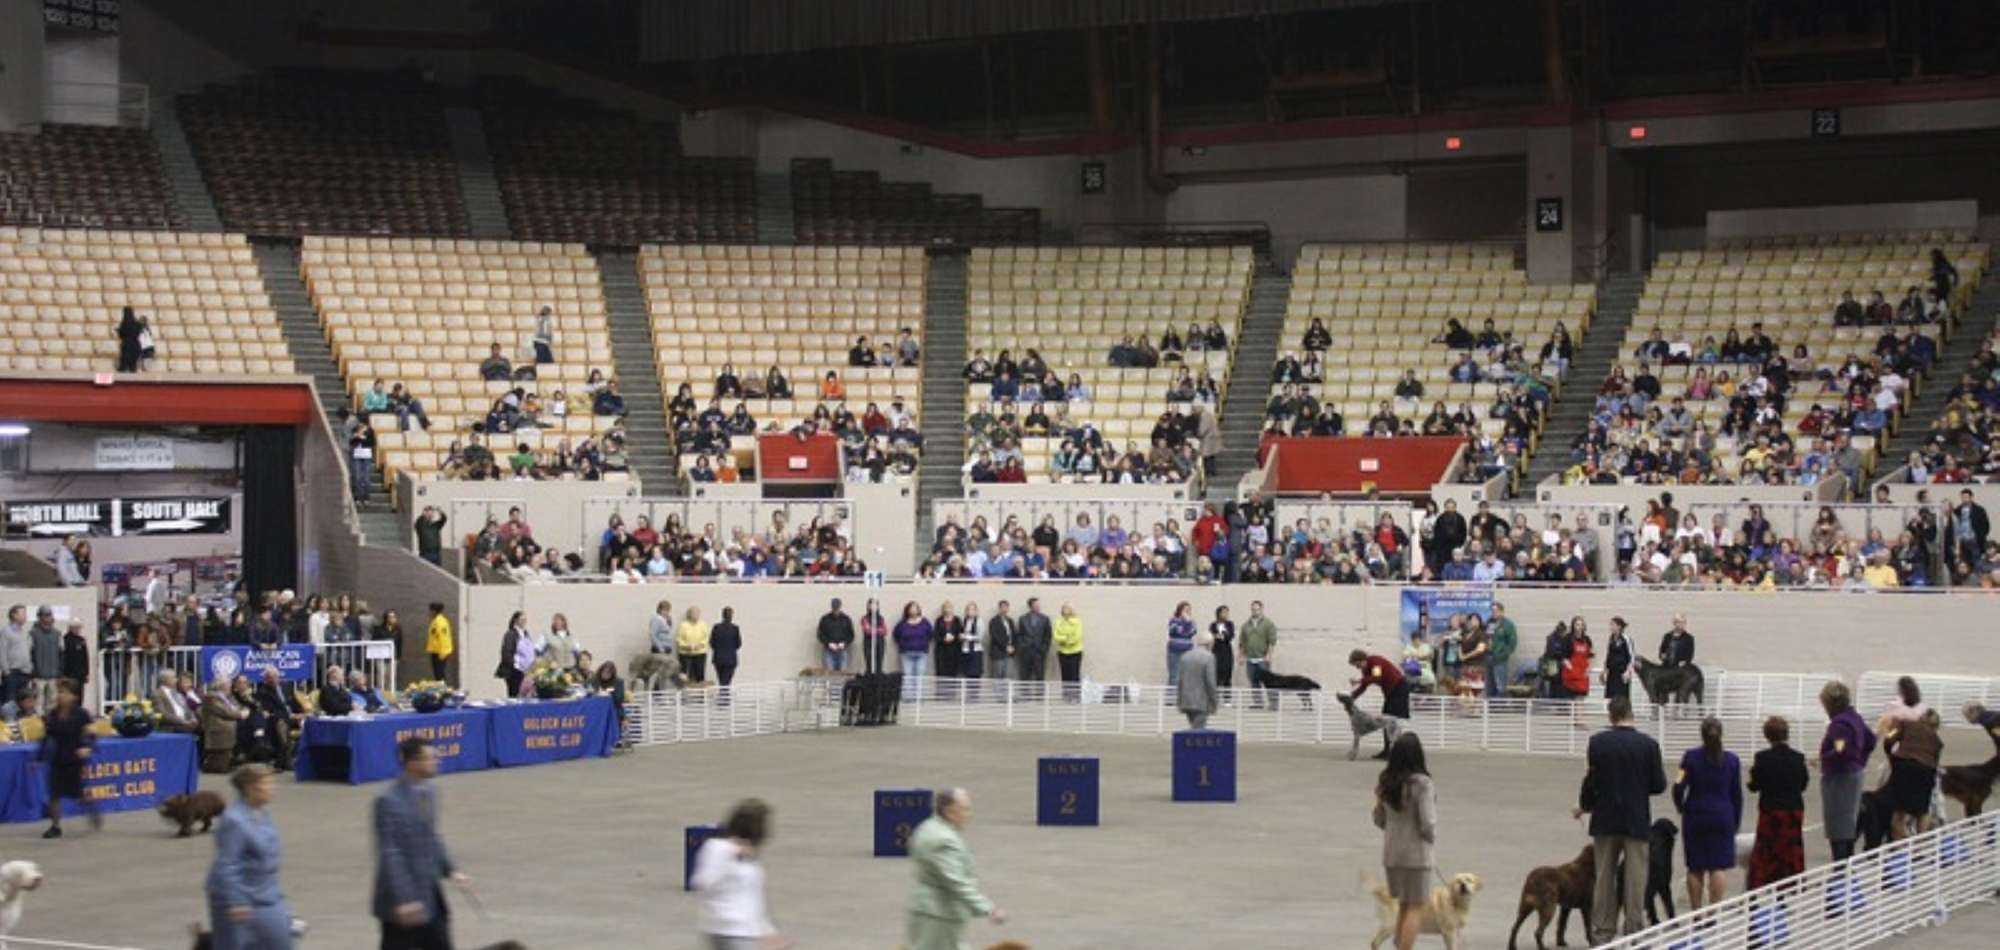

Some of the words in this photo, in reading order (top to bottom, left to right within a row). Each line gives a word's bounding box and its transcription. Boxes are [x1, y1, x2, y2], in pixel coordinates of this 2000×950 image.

[1816, 117, 1836, 134] 22
[1541, 208, 1558, 225] 24
[66, 502, 101, 521] HALL
[132, 502, 182, 519] SOUTH
[186, 500, 219, 518] HALL
[868, 572, 883, 588] 11
[439, 723, 463, 739] GATE
[523, 717, 560, 730] GOLDEN
[562, 715, 585, 729] GATE
[526, 735, 557, 749] KENNEL
[559, 732, 582, 747] CLUB
[81, 762, 121, 779] OLDEN
[124, 757, 156, 775] GATE
[1197, 765, 1211, 786] 1
[83, 783, 120, 800] ENNEL
[124, 780, 156, 797] CLUB
[1059, 791, 1078, 815] 2
[895, 822, 913, 848] 3
